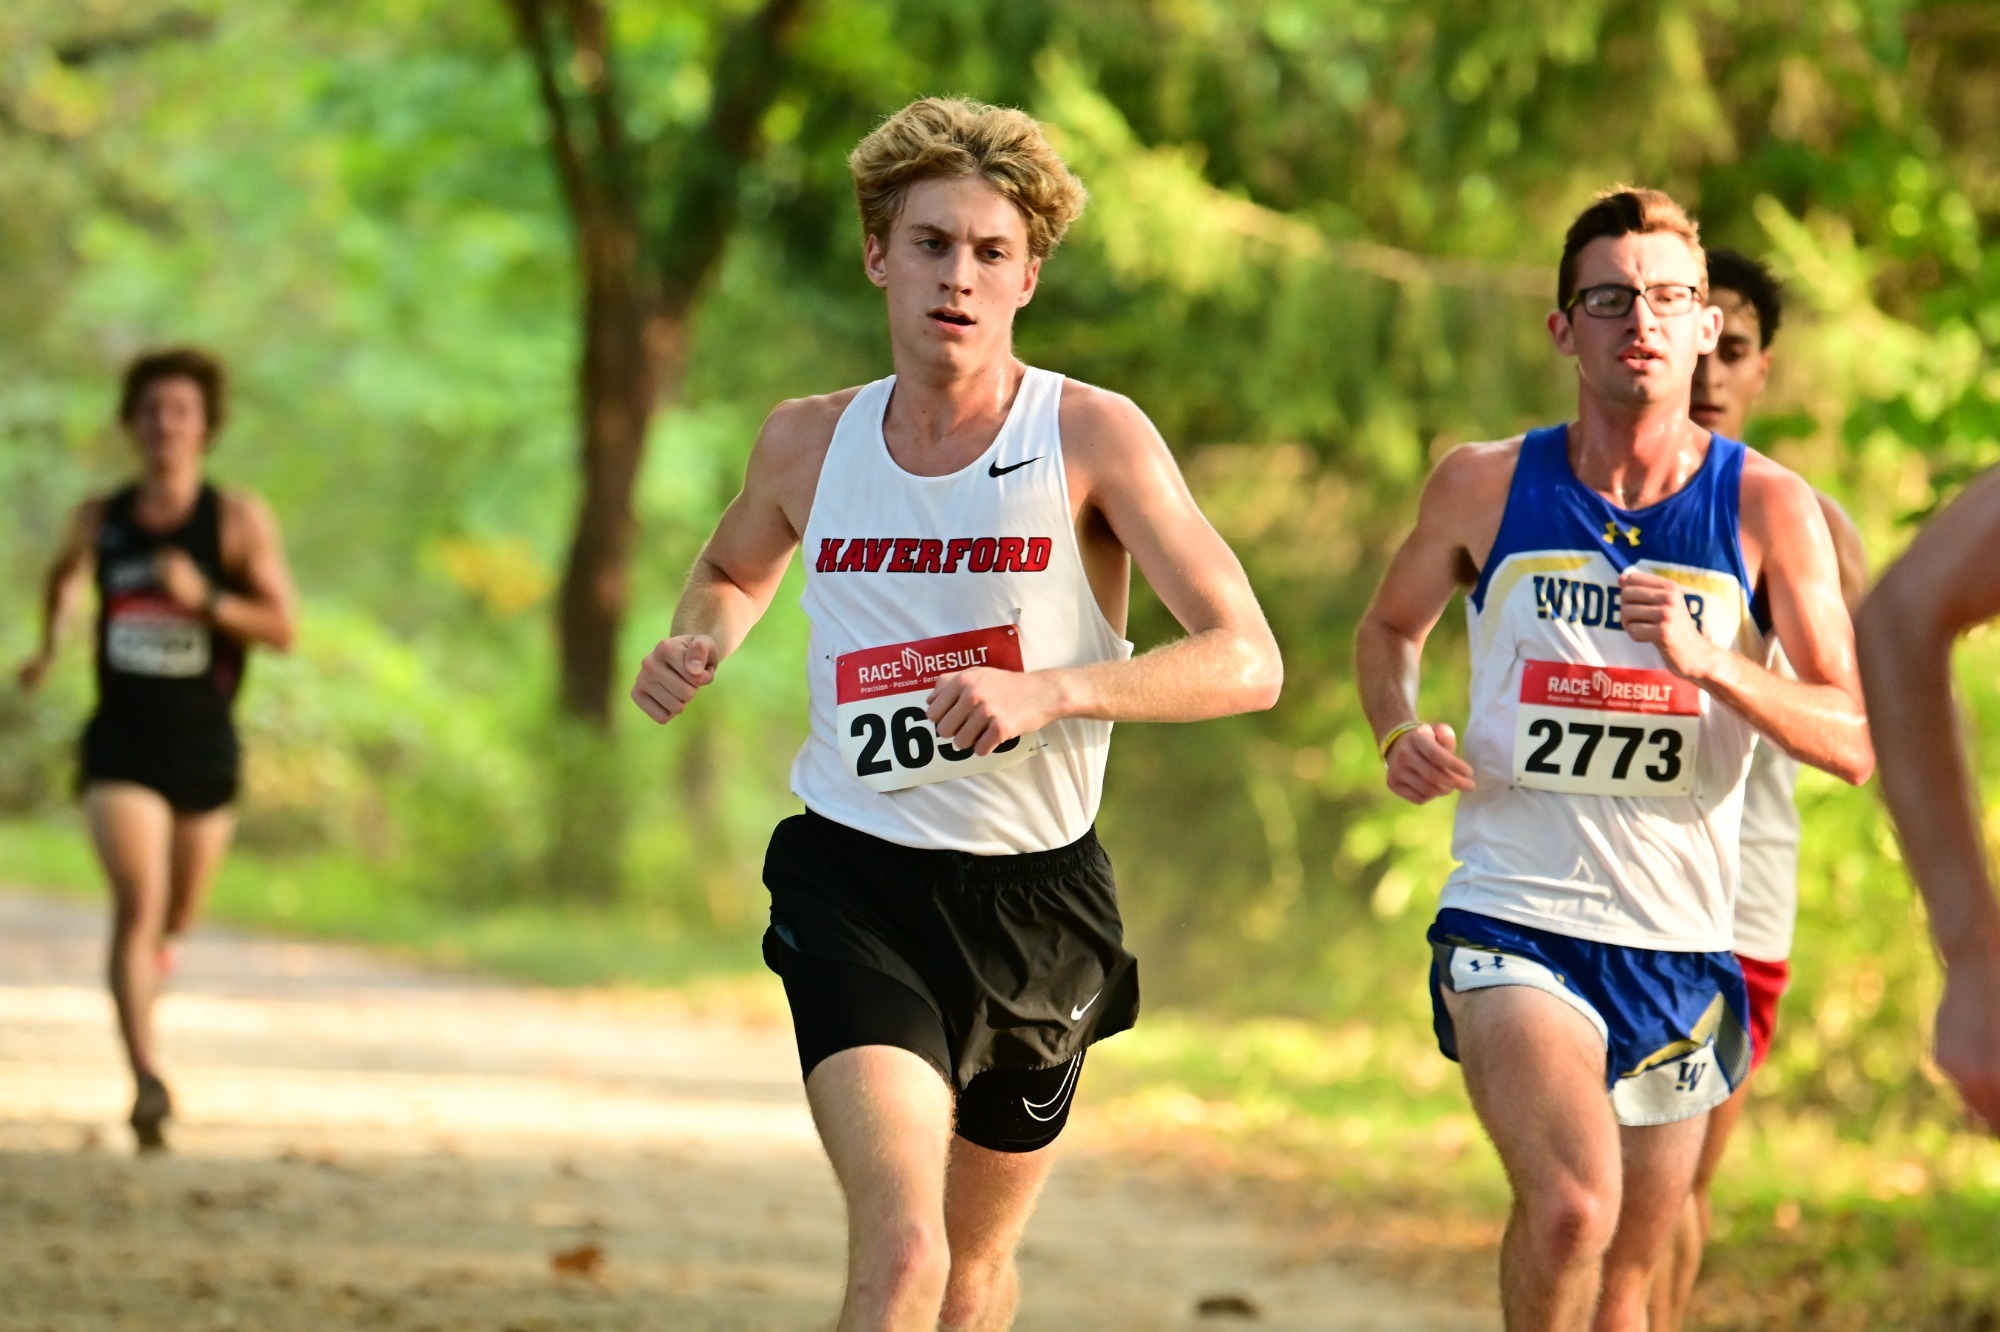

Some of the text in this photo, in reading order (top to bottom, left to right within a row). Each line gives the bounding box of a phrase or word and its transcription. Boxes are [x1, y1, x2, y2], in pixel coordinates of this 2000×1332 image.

[815, 536, 1052, 574] HAVERFORD
[1533, 575, 1704, 635] WIDER
[858, 646, 988, 684] RACE RESULT
[860, 683, 889, 694] Precision
[893, 678, 918, 689] Passion
[1548, 676, 1673, 702] RACE RESULT
[1525, 718, 1683, 783] 2773
